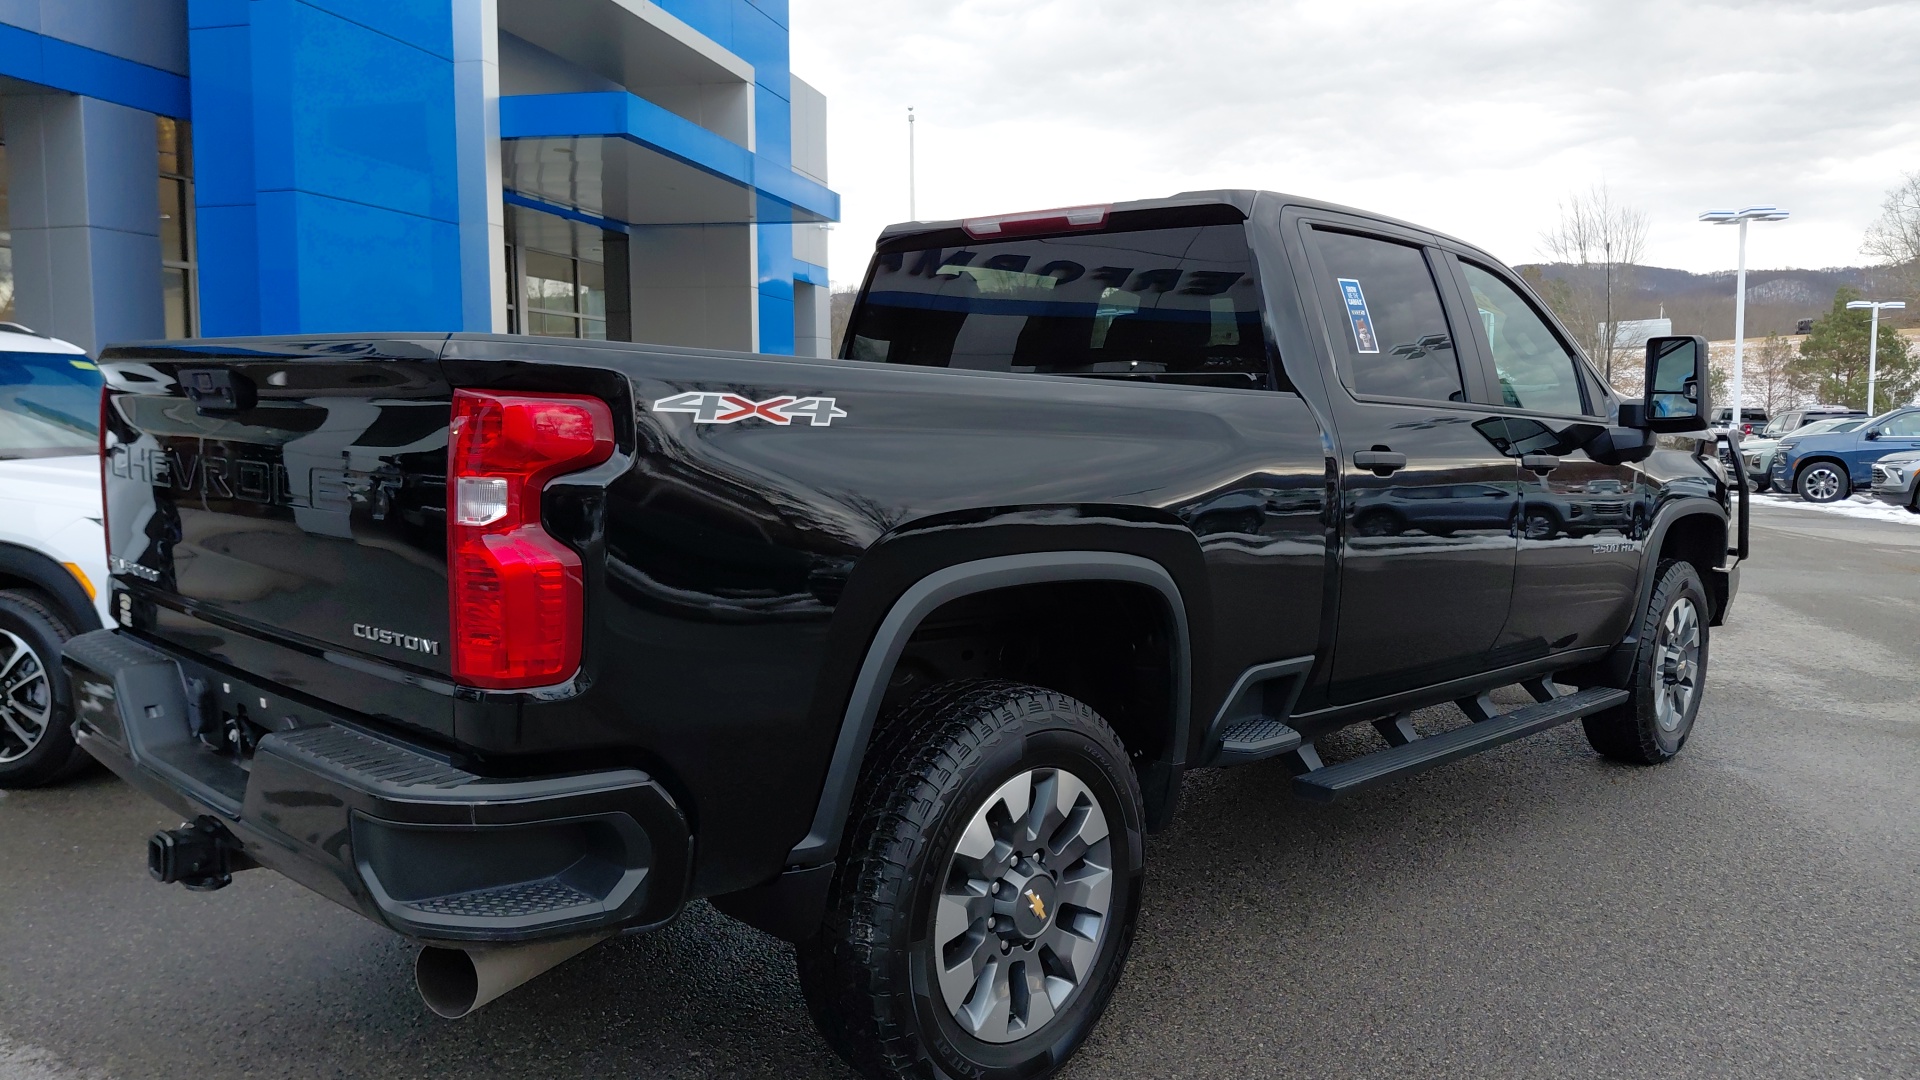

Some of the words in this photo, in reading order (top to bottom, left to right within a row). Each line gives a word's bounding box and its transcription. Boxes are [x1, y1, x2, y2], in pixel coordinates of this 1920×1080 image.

[111, 444, 404, 520] CHEVROLET
[1593, 543, 1619, 554] 2500
[353, 622, 439, 656] CUSTOM
